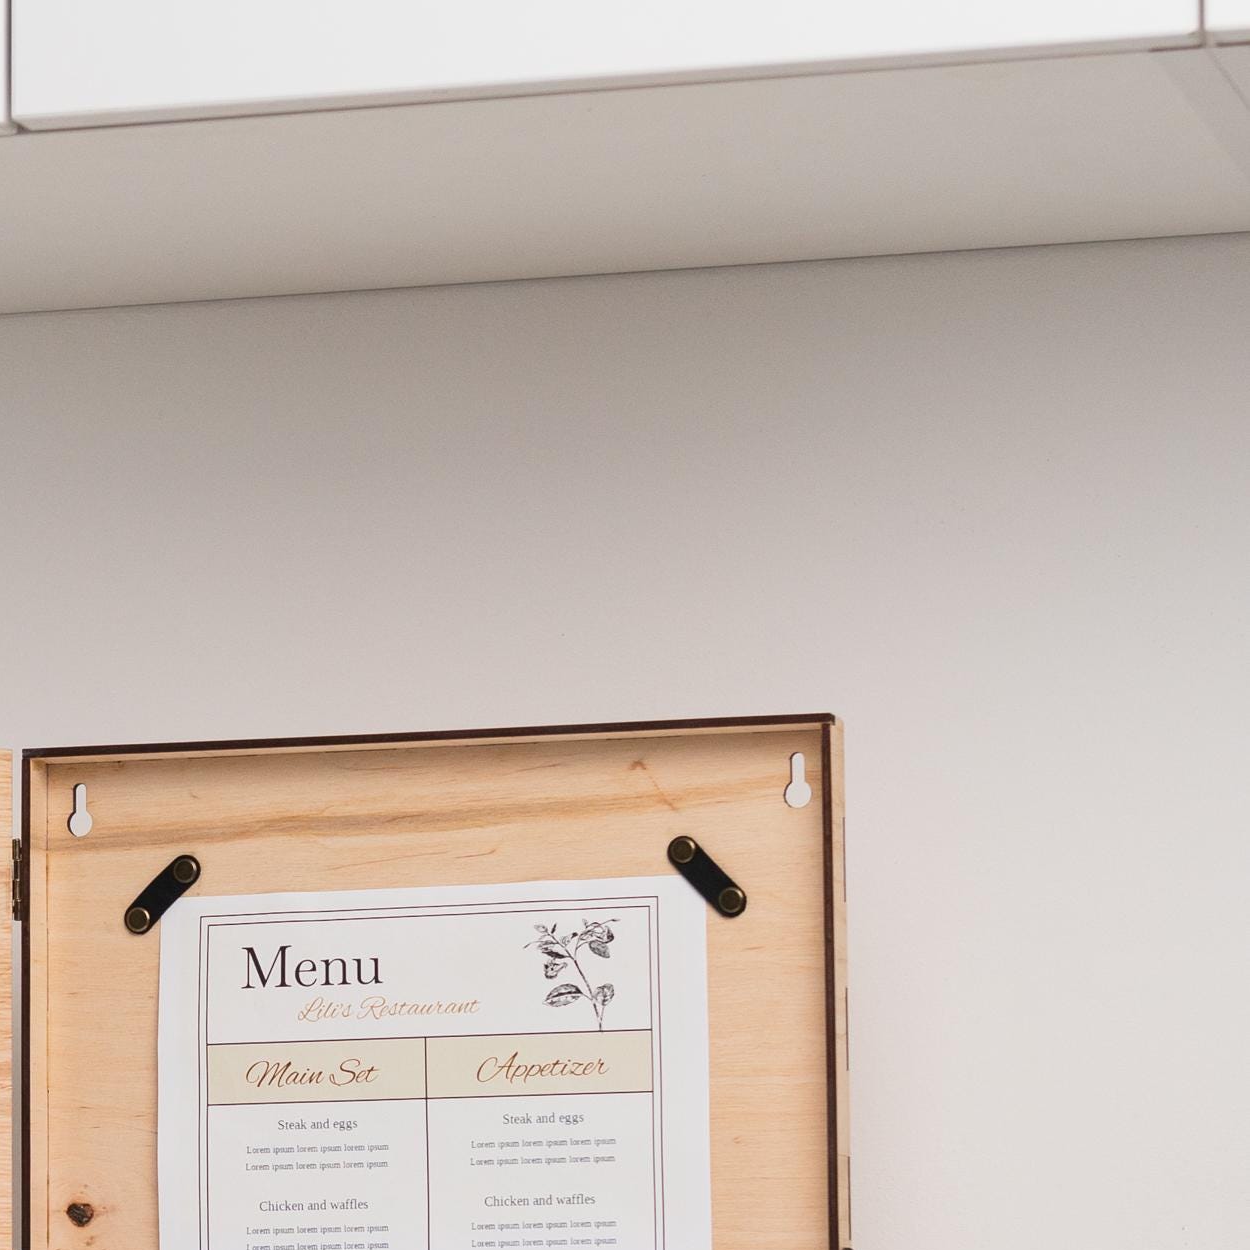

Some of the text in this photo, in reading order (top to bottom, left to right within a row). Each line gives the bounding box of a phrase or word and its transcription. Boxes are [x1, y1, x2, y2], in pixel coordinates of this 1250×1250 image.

[241, 945, 384, 989] Menu
[298, 996, 479, 1022] Lili's Restaurant
[246, 1059, 379, 1088] Main Set
[477, 1051, 608, 1084] Appetizer
[277, 1117, 358, 1132] Steak and eggs
[502, 1111, 585, 1126] Steak and eggs
[246, 1143, 389, 1156] Lorem ipsum lorem ipsum lorem ipsum
[245, 1160, 389, 1173] Lorem ipsum lorem ipsum lorem ipsum
[470, 1157, 495, 1166] Lorem
[496, 1158, 519, 1167] ipsum
[520, 1157, 543, 1165] lorem
[544, 1157, 567, 1166] ipsum
[593, 1155, 616, 1164] ipsum
[259, 1198, 369, 1212] Chicken and waffles
[484, 1193, 596, 1208] Chicken and waffles
[246, 1225, 389, 1237] Lorem ipsum lorem ipsum lorem ipsum
[296, 1242, 319, 1250] lorem
[343, 1241, 366, 1250] lorem
[367, 1242, 389, 1250] ipsum
